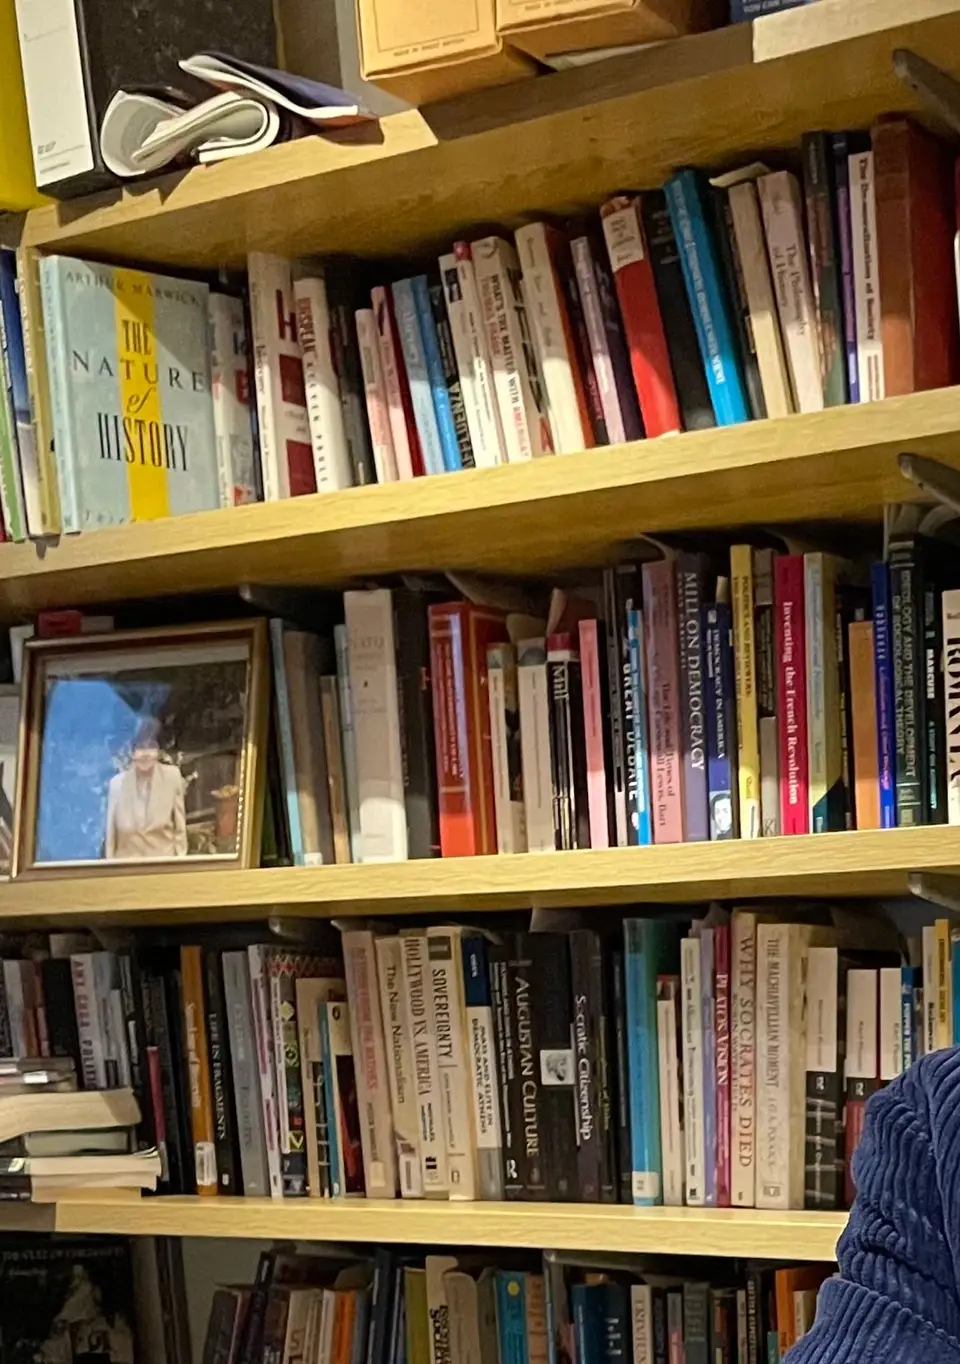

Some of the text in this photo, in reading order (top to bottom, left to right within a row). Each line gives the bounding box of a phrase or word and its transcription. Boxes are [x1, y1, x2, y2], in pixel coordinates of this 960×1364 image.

[786, 244, 799, 268] The
[859, 158, 868, 180] The
[865, 282, 874, 295] of
[65, 270, 127, 292] ARTHUR
[72, 350, 206, 393] NATURE
[121, 320, 152, 355] THE
[502, 336, 516, 376] MATTER
[127, 387, 152, 413] of
[507, 378, 520, 404] WITH
[98, 413, 189, 472] HISTORY
[552, 664, 569, 700] Mill
[683, 572, 704, 770] MILL ON DEMOCRACY
[712, 628, 726, 758] DEMOCRACY IN AMERICA
[782, 602, 798, 805] Inventing the French Revolution
[900, 570, 917, 778] IDEOLOGY AND THE DEVELOPMENT
[926, 648, 935, 699] MARCUSE
[625, 730, 639, 801] DEBATE
[666, 785, 676, 797] of
[386, 964, 406, 1105] The New Nationalism
[403, 938, 433, 1097] HOLLYWOOD AMERICA
[432, 968, 453, 1059] SOVEREIGNTY
[738, 936, 754, 1168] WHY SOCRATES DIED
[765, 938, 780, 1089] THE MACHIAVELLIAN MOMENT
[208, 1013, 228, 1141] LIFE IN FRAGMENTS
[471, 1018, 487, 1134] DEMOCRATIC ATHENS
[481, 1057, 490, 1081] AND
[486, 1115, 493, 1126] IN
[514, 976, 540, 1158] AUGUSTAN CULTURE
[575, 994, 594, 1140] Socratic Citizenship
[716, 1035, 729, 1086] VISION
